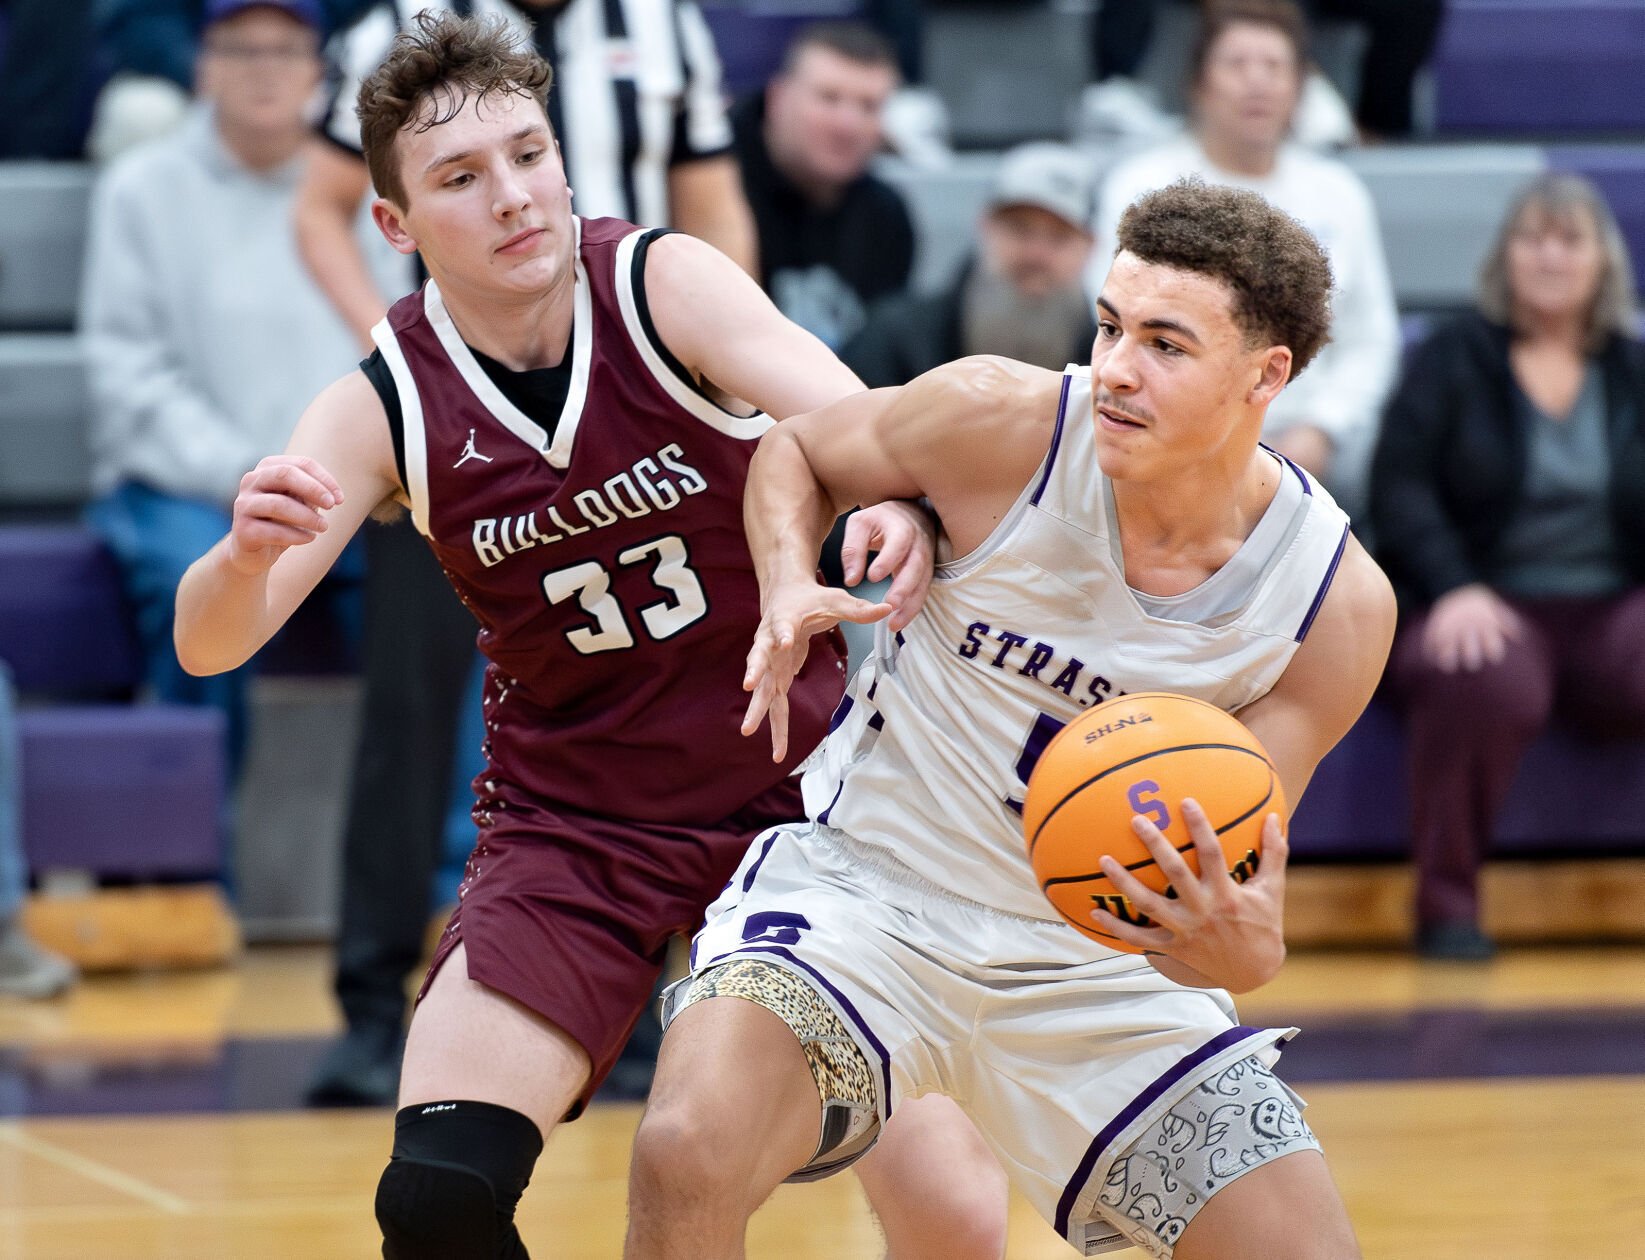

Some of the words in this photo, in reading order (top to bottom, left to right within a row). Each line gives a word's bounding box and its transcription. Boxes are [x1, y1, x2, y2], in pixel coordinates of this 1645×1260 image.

[472, 442, 708, 568] BULLDOGS
[541, 533, 709, 656] 33
[958, 621, 1128, 706] STRAS
[1127, 780, 1171, 831] S
